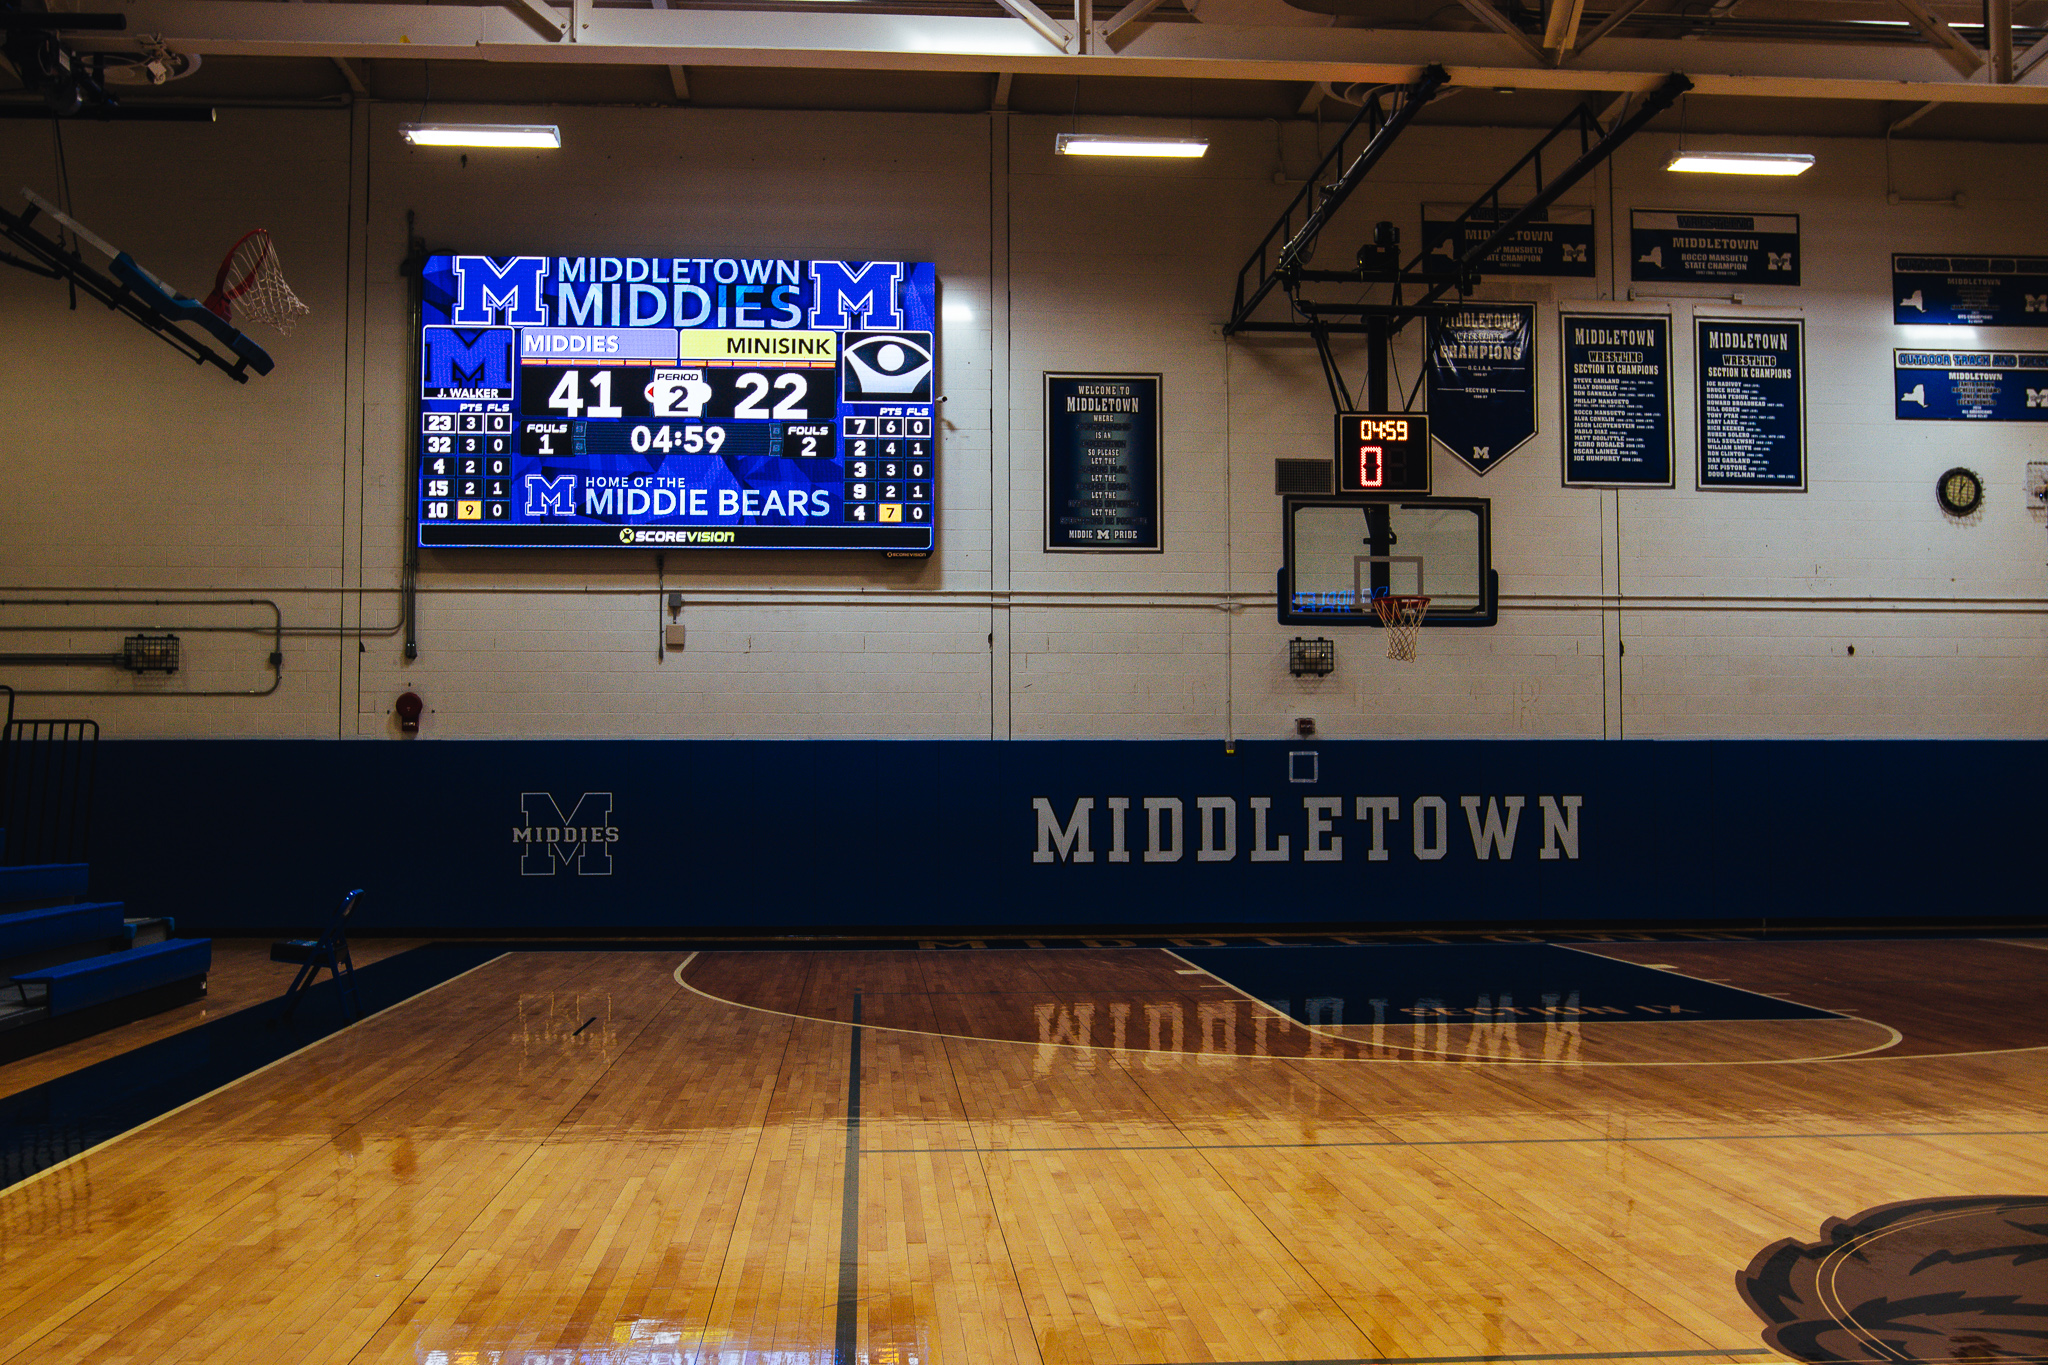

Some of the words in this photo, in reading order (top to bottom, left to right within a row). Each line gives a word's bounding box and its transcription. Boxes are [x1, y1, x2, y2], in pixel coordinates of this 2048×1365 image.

[1672, 237, 1759, 250] MIDDLETOWN
[1501, 254, 1541, 262] CHAMPION
[1682, 253, 1707, 261] ROCCO
[1709, 254, 1748, 262] MANSUETO
[1708, 262, 1747, 270] CHAMPION
[1947, 278, 2000, 286] MIDDLETOWN
[452, 255, 549, 327] M
[558, 256, 800, 285] MIDDLETOWN
[808, 259, 904, 330] M
[558, 283, 801, 328] MIDDIES
[525, 335, 620, 353] MIDDIES
[1575, 328, 1654, 347] MIDDLETOWN
[1710, 331, 1788, 350] MIDDLETOWN
[727, 338, 831, 355] MINISINK
[1440, 344, 1522, 360] CHAMPIONS
[1588, 350, 1643, 363] WRESTLING
[1722, 354, 1776, 367] WRESTLING
[1900, 353, 1950, 366] OUTDOOR
[1954, 354, 1990, 367] TRACK
[1992, 355, 2018, 368] AND
[657, 373, 699, 381] PERIOD
[1574, 364, 1605, 374] SECTION
[1607, 364, 1614, 374] IX
[1617, 364, 1659, 375] CHAMPIONS
[1708, 367, 1738, 377] SECTION
[1741, 368, 1748, 378] IX
[1751, 368, 1791, 378] CHAMPIONS
[1949, 372, 2003, 380] MIDDLETOWN
[437, 388, 448, 398] J.
[450, 389, 498, 398] WALKER
[548, 370, 622, 418] 41
[735, 372, 808, 420] 22
[1078, 386, 1116, 395] WELCOME
[1120, 386, 1130, 395] TO
[668, 385, 689, 412] 2
[1066, 396, 1139, 412] MIDDLETOWN
[460, 404, 482, 412] PTS
[487, 404, 509, 412] FLS
[879, 408, 902, 416] PTS
[906, 408, 929, 416] FLS
[428, 415, 451, 431] 23
[466, 417, 476, 430] 3
[494, 417, 503, 430] 0
[526, 424, 568, 433] FOULS
[788, 426, 828, 435] FOULS
[854, 420, 866, 434] 7
[886, 421, 896, 433] 6
[913, 421, 923, 434] 0
[1360, 420, 1408, 440] 04:59
[428, 437, 451, 452] 32
[466, 438, 475, 451] 3
[493, 438, 503, 451] 0
[538, 434, 554, 454] 1
[630, 425, 726, 453] 04:59
[801, 437, 816, 456] 2
[854, 441, 866, 456] 2
[885, 443, 896, 455] 4
[914, 443, 923, 455] 1
[1473, 446, 1489, 459] M
[433, 458, 445, 474] 4
[465, 461, 475, 473] 2
[493, 461, 503, 473] 0
[854, 462, 866, 477] 3
[886, 464, 896, 476] 3
[913, 464, 923, 476] 0
[1360, 447, 1382, 486] 0
[428, 481, 449, 496] 15
[465, 482, 475, 495] 2
[493, 482, 502, 495] 1
[585, 477, 628, 488] HOME
[634, 477, 653, 488] OF
[657, 478, 685, 488] THE
[525, 474, 577, 516] M
[854, 484, 866, 499] 9
[886, 486, 896, 498] 2
[913, 486, 922, 498] 1
[585, 488, 708, 516] MIDDIE
[719, 490, 830, 516] BEARS
[428, 503, 448, 518] 10
[465, 505, 474, 516] 9
[493, 504, 502, 516] 0
[854, 505, 865, 520] 4
[886, 508, 894, 518] 7
[913, 507, 922, 520] 0
[635, 531, 735, 543] SCOREVISION
[1069, 530, 1093, 539] MIDDIE
[1097, 530, 1110, 539] M
[1114, 530, 1138, 538] PRIDE
[512, 827, 619, 842] MIDDIES
[1032, 796, 1582, 863] MIDDLETOWN
